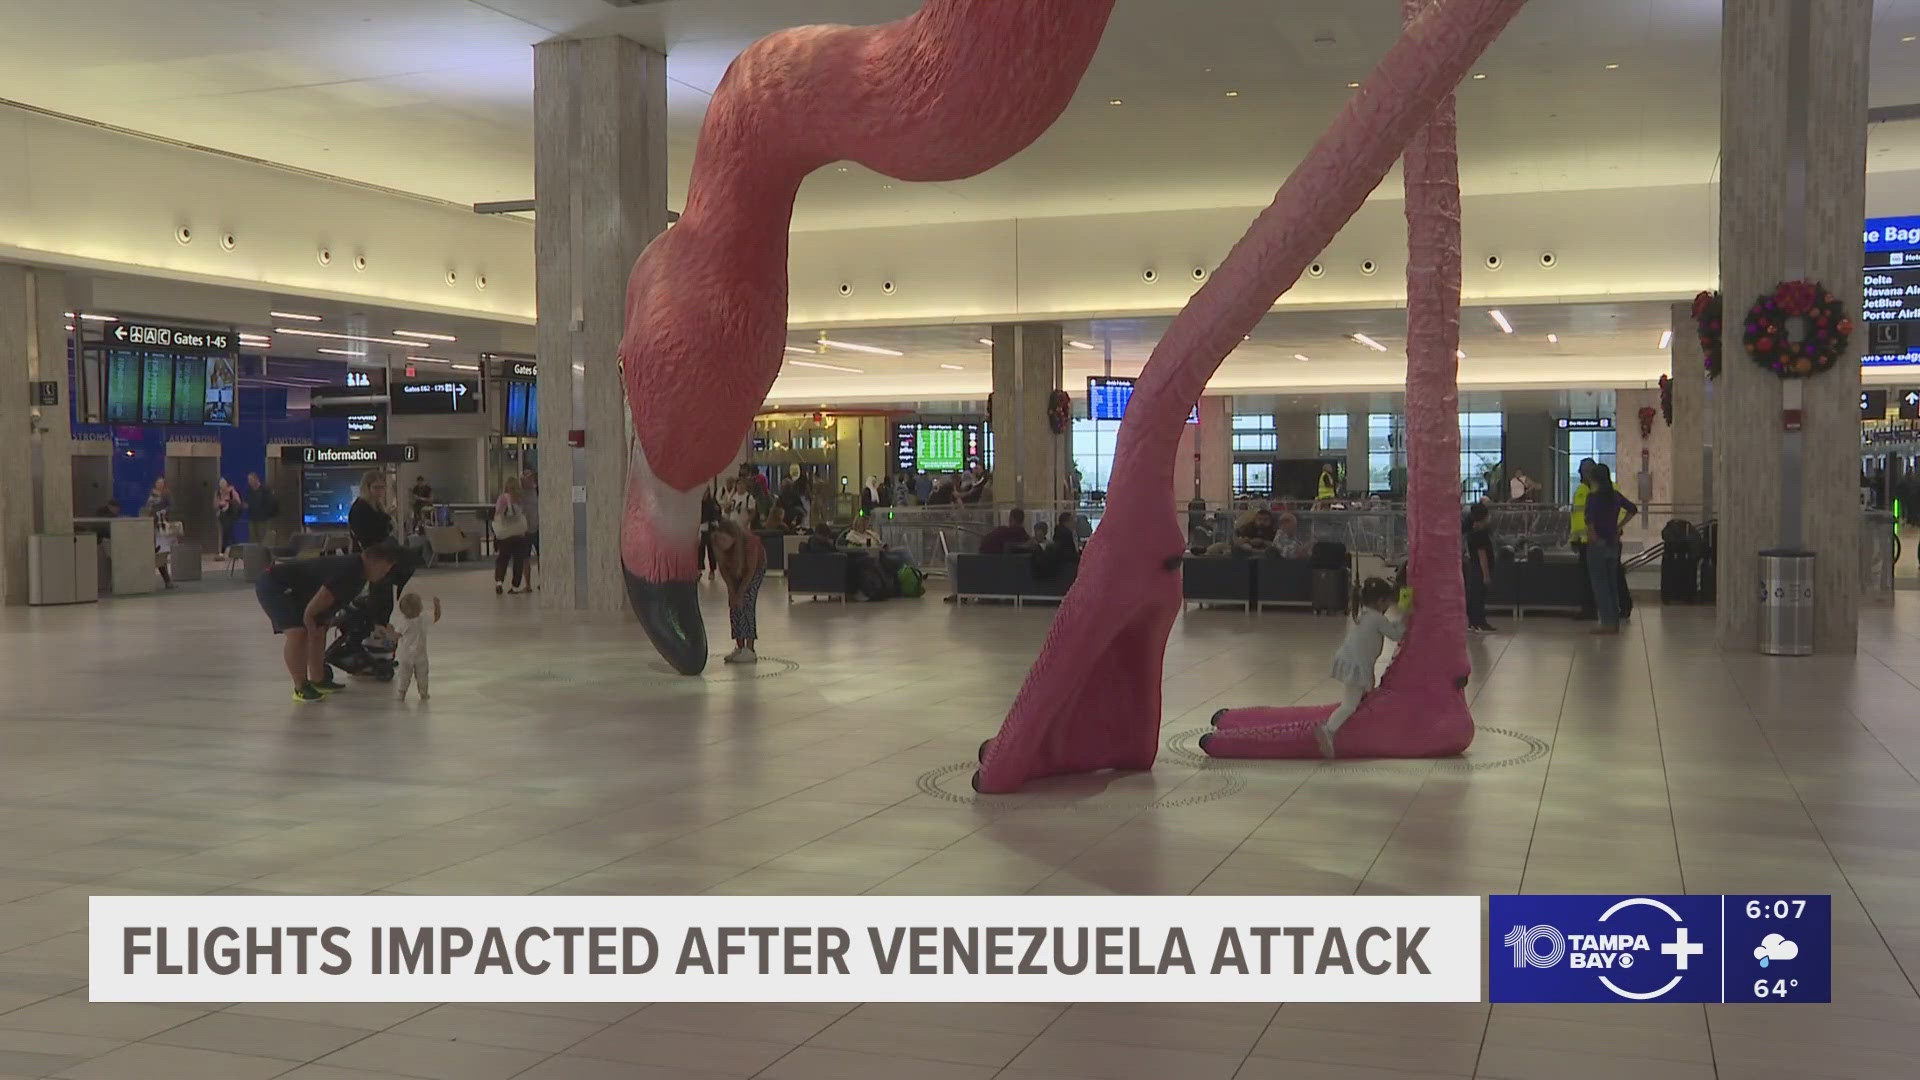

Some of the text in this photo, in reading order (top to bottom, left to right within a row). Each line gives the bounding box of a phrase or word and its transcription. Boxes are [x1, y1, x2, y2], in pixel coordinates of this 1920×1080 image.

[1885, 226, 1920, 244] Bag
[1864, 275, 1893, 285] Delta
[1863, 287, 1904, 297] Havana
[1862, 298, 1903, 308] JetBlue
[1863, 310, 1898, 320] Porter
[173, 332, 203, 346] Gates
[205, 335, 227, 348] 1-45
[514, 364, 532, 375] Gates
[317, 448, 378, 461] Information
